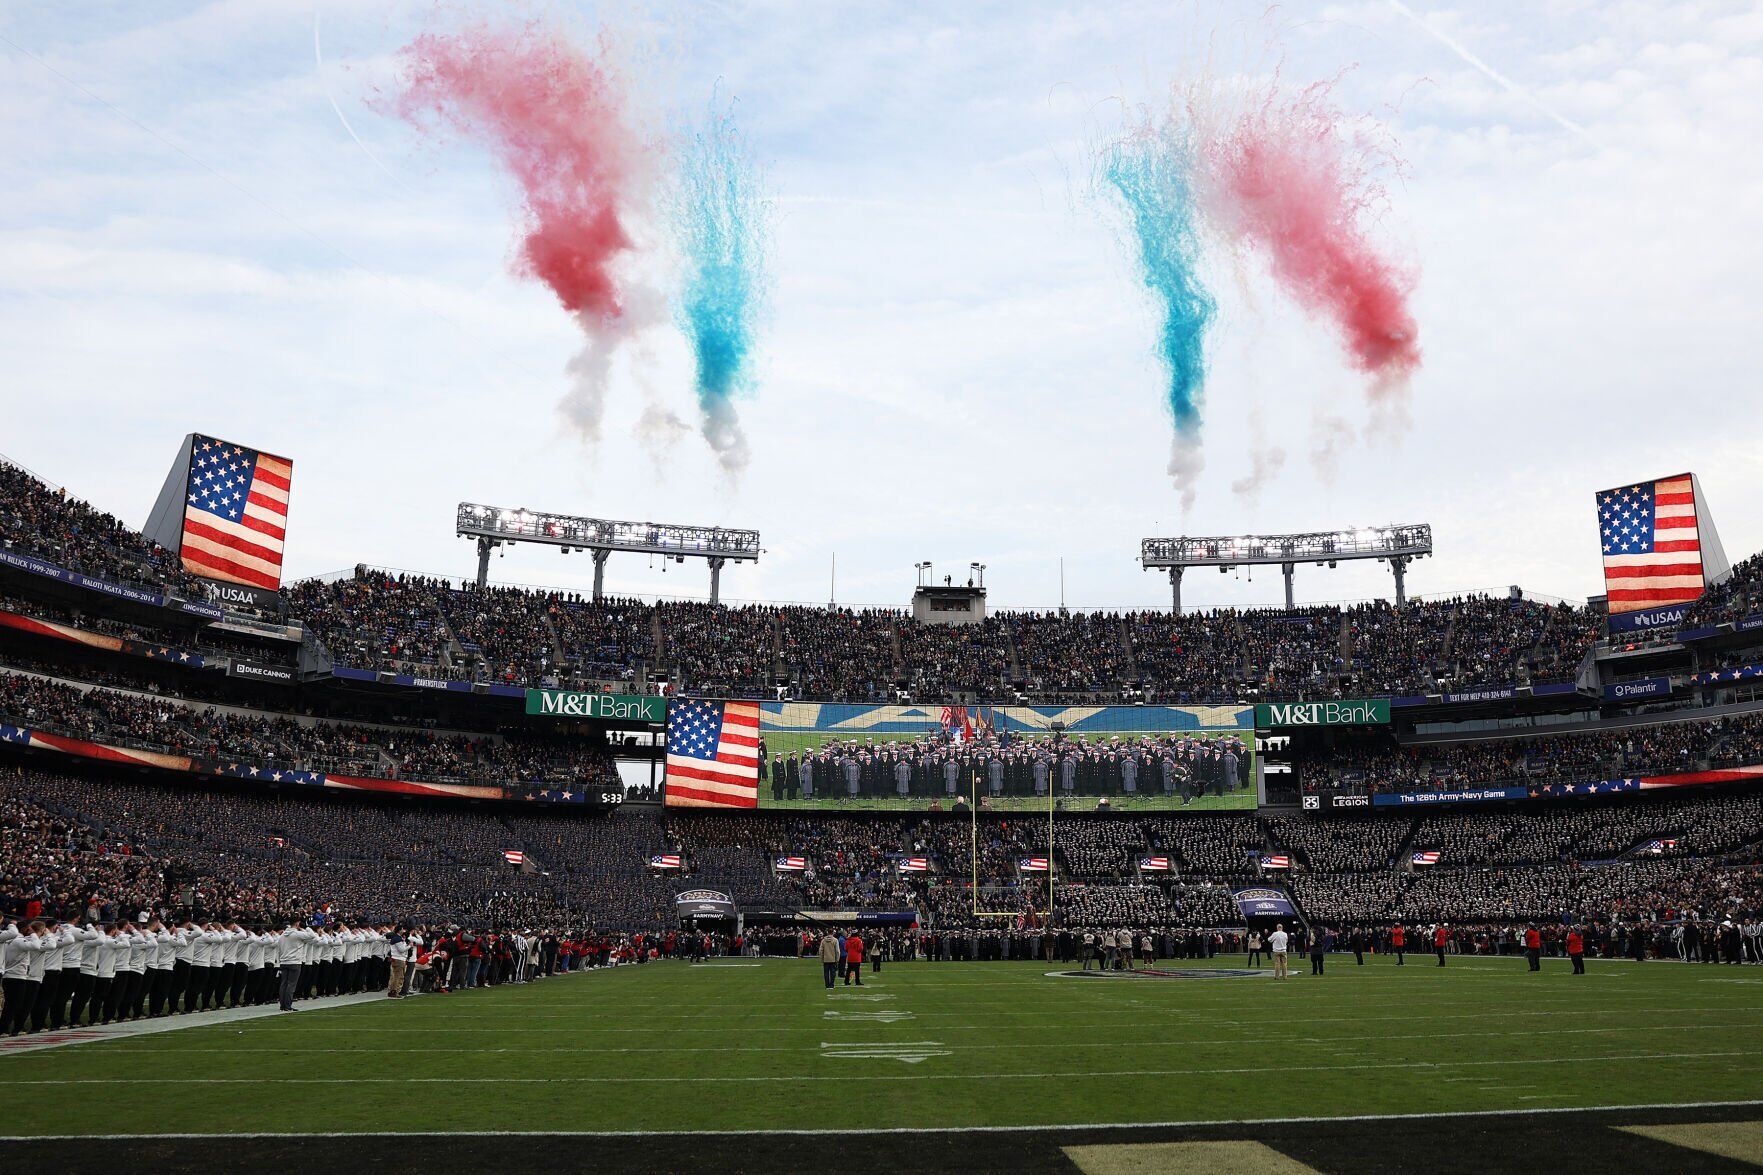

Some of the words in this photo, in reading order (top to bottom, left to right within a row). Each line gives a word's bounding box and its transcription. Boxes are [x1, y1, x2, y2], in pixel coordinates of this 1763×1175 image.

[7, 555, 28, 568] BILLICK
[29, 562, 60, 577] 1999-2007
[82, 578, 103, 590] HALOTI
[103, 584, 122, 595] NGATA
[123, 589, 155, 603] 2006-2014
[221, 587, 254, 604] USAA
[200, 606, 221, 617] HONOR
[1650, 610, 1683, 625] USAA
[245, 666, 262, 675] DUKE
[263, 669, 291, 679] CANNON
[413, 678, 448, 689] #RAVENSFLOCK
[1624, 682, 1657, 695] Palantir
[1460, 693, 1469, 701] FOR
[1470, 692, 1481, 700] HELP
[540, 691, 599, 716] M&T
[600, 695, 653, 720] Bank
[1269, 703, 1323, 726] M&T
[1326, 702, 1378, 724] Bank
[601, 792, 623, 804] 5:33
[1305, 797, 1318, 808] 25
[1332, 799, 1369, 807] LEGION
[1400, 795, 1415, 803] The
[1438, 791, 1482, 801] Army-Navy
[1484, 790, 1505, 798] Game
